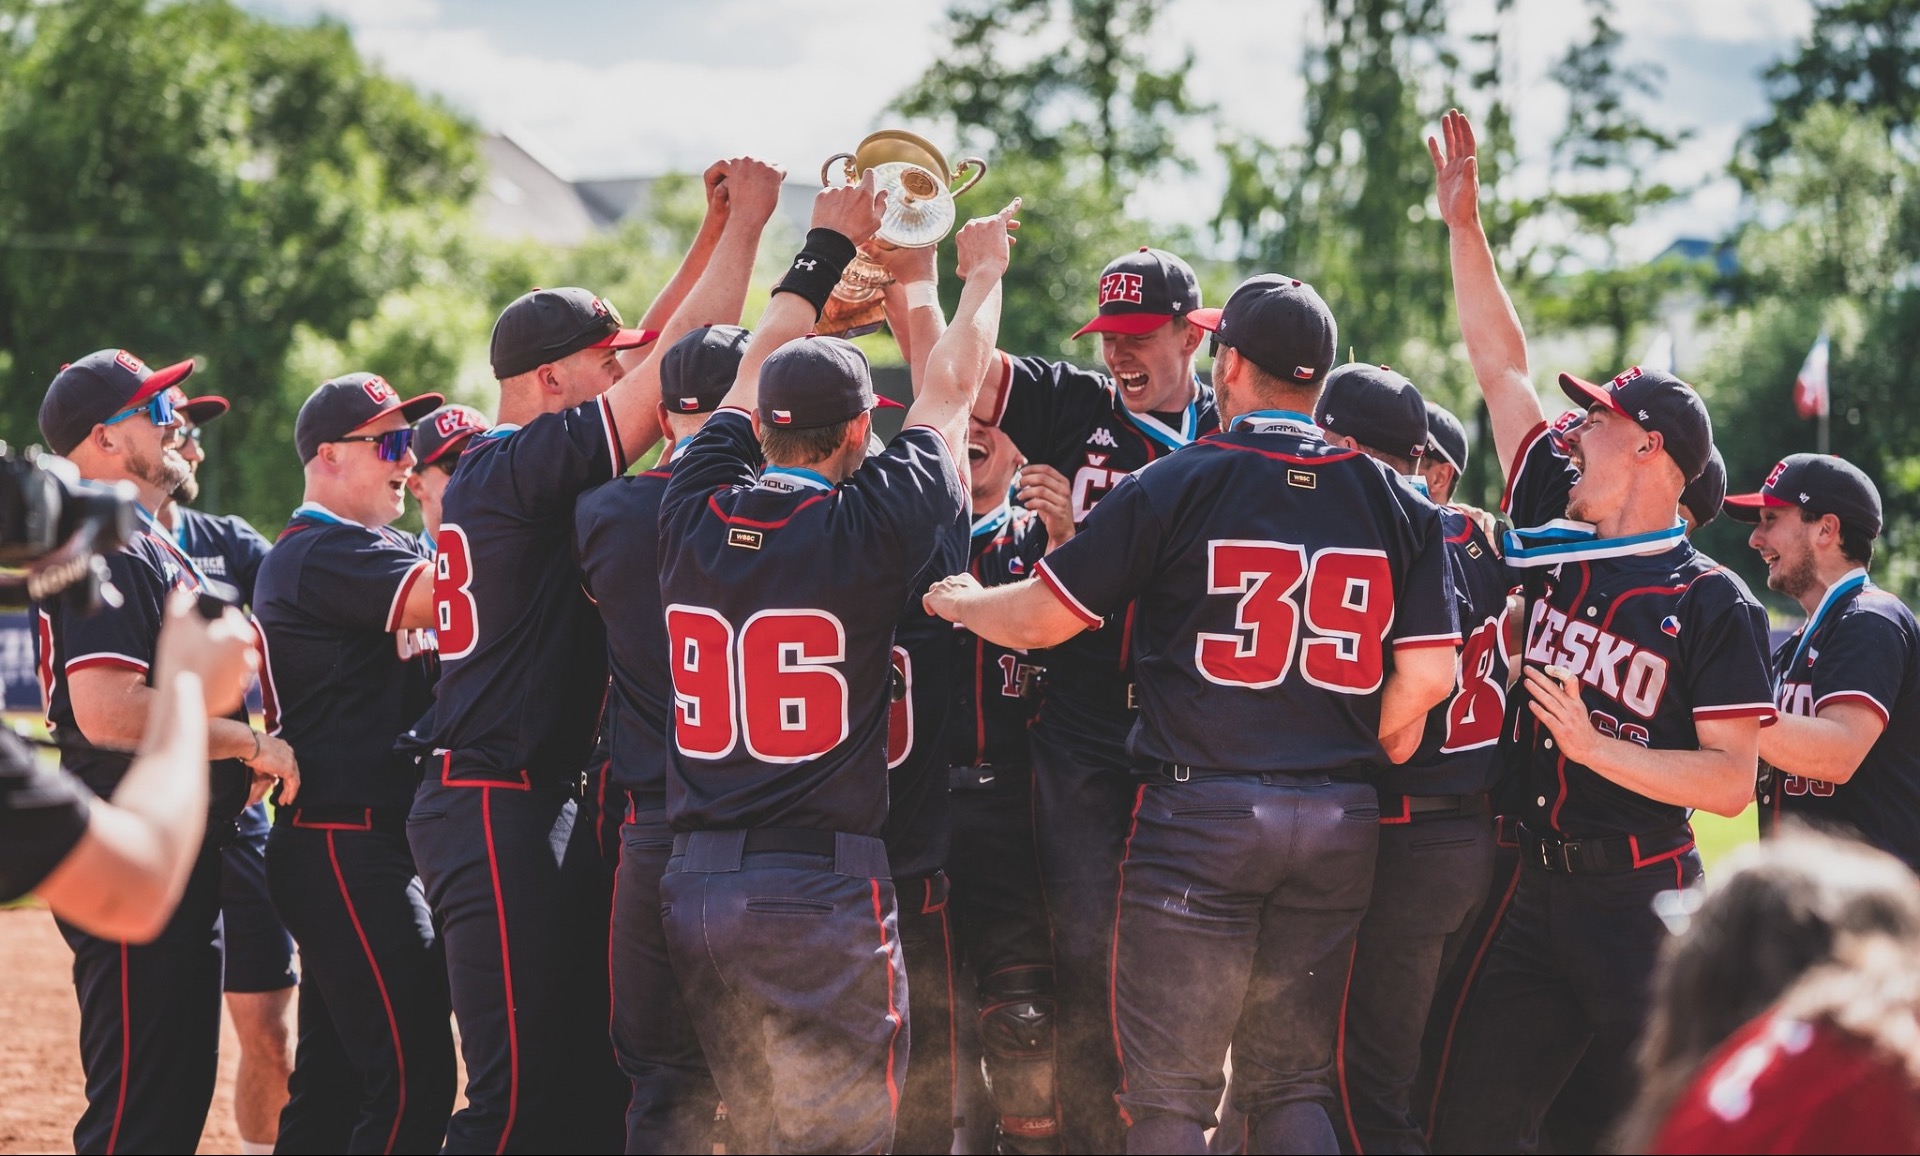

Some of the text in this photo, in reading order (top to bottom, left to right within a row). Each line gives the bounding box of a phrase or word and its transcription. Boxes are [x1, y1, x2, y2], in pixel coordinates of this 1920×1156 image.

[434, 408, 488, 438] CZ
[1263, 424, 1308, 435] ARM
[759, 479, 795, 493] MOUR
[1195, 539, 1395, 695] 39
[665, 603, 850, 764] 96
